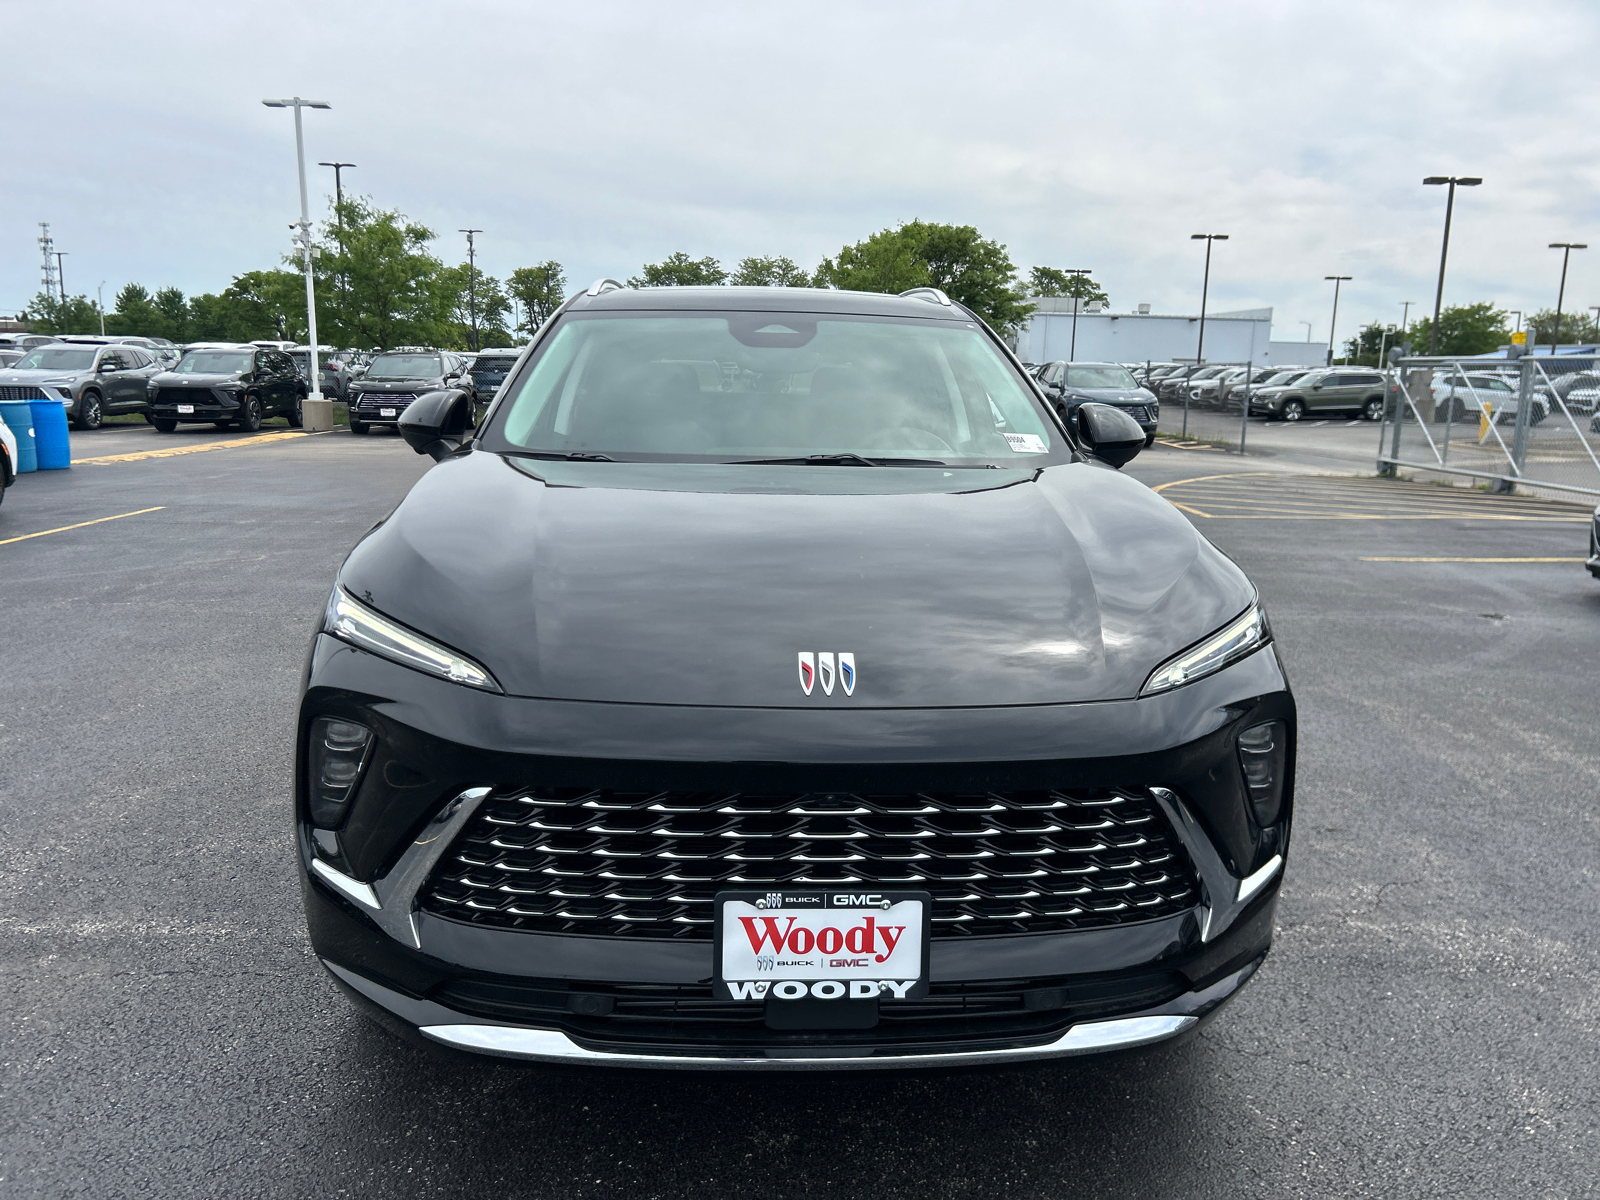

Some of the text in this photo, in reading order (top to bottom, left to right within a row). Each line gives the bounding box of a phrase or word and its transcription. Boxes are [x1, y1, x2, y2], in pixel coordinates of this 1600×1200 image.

[833, 894, 882, 906] GMC
[738, 916, 906, 963] Woody
[829, 958, 869, 967] GMC
[726, 980, 917, 1000] WOODY
